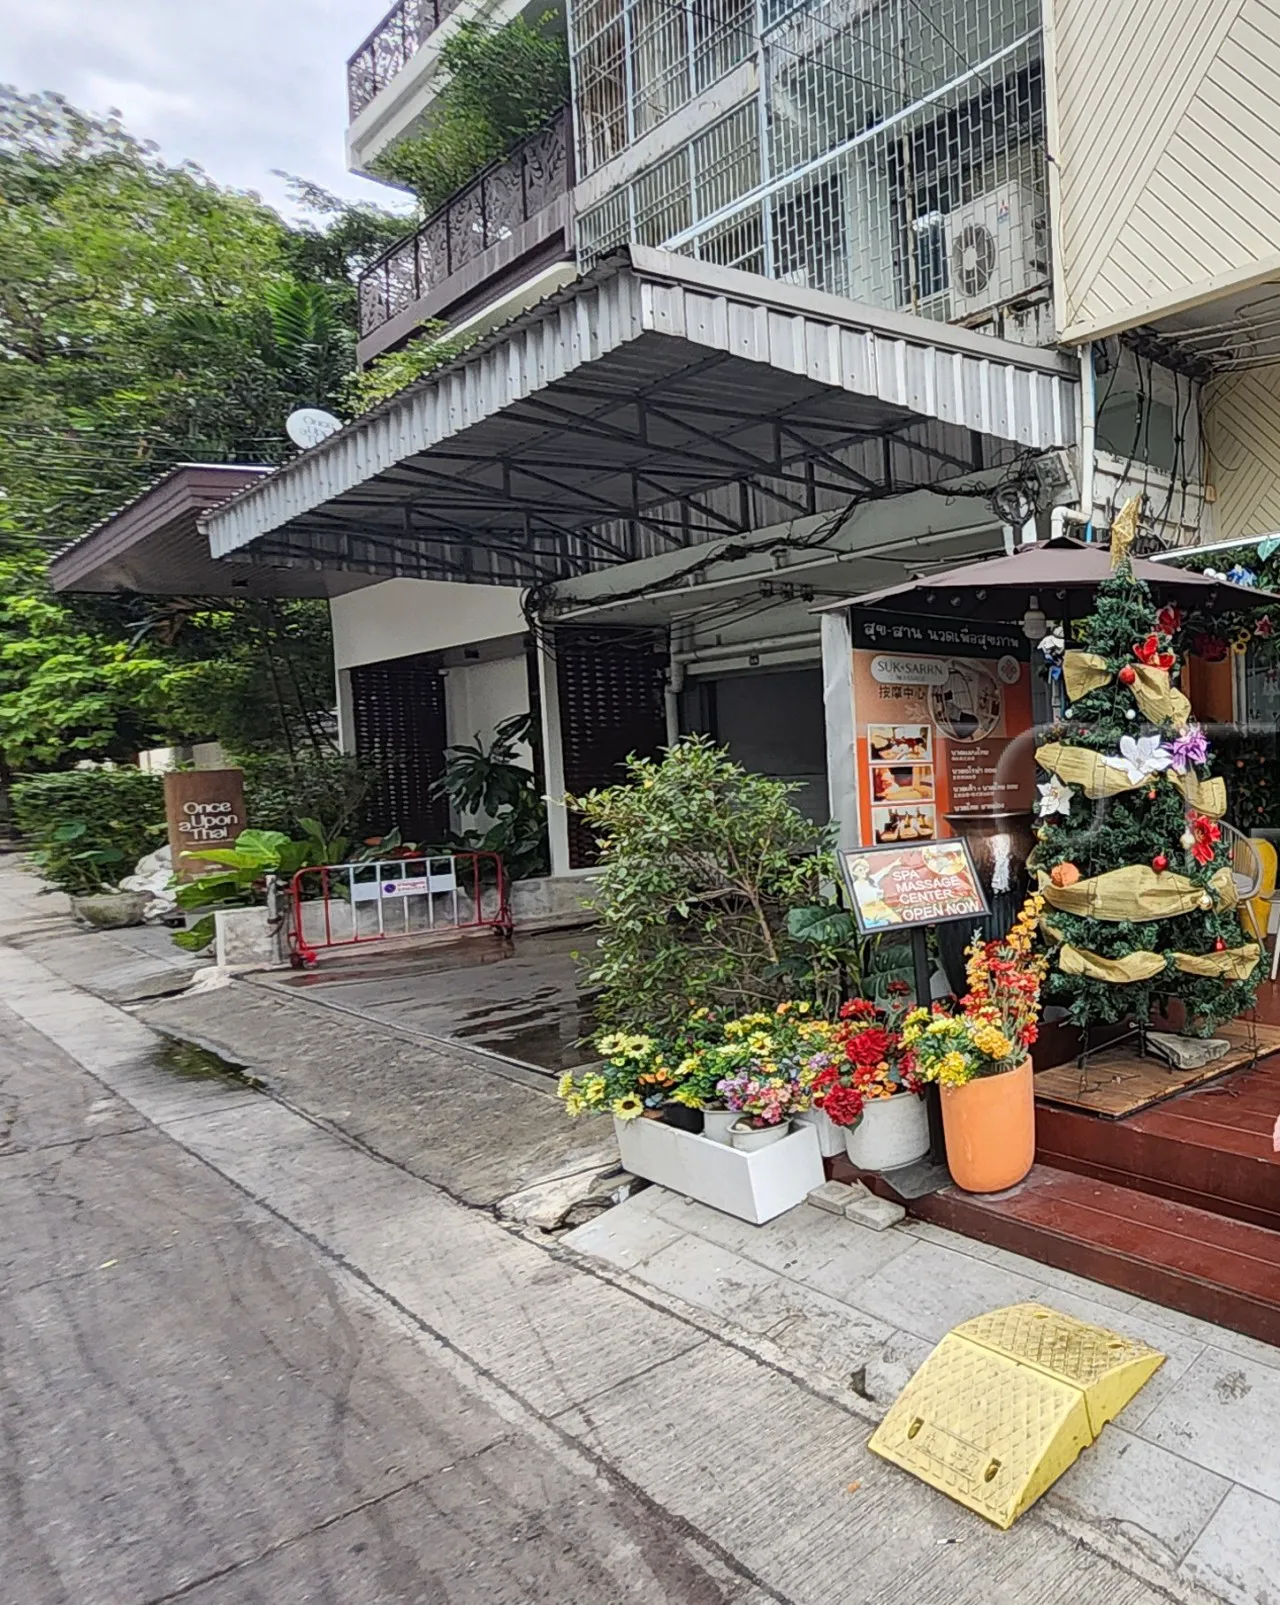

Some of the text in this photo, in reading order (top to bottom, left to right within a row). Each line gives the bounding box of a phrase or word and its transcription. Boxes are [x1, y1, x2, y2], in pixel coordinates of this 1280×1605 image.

[183, 802, 232, 815] Once
[178, 814, 239, 832] a Upon
[190, 826, 228, 840] Thai
[892, 870, 920, 882] SPA
[895, 876, 961, 893] MASSAGE
[899, 889, 953, 905] CENTER
[902, 904, 945, 921] OPEN
